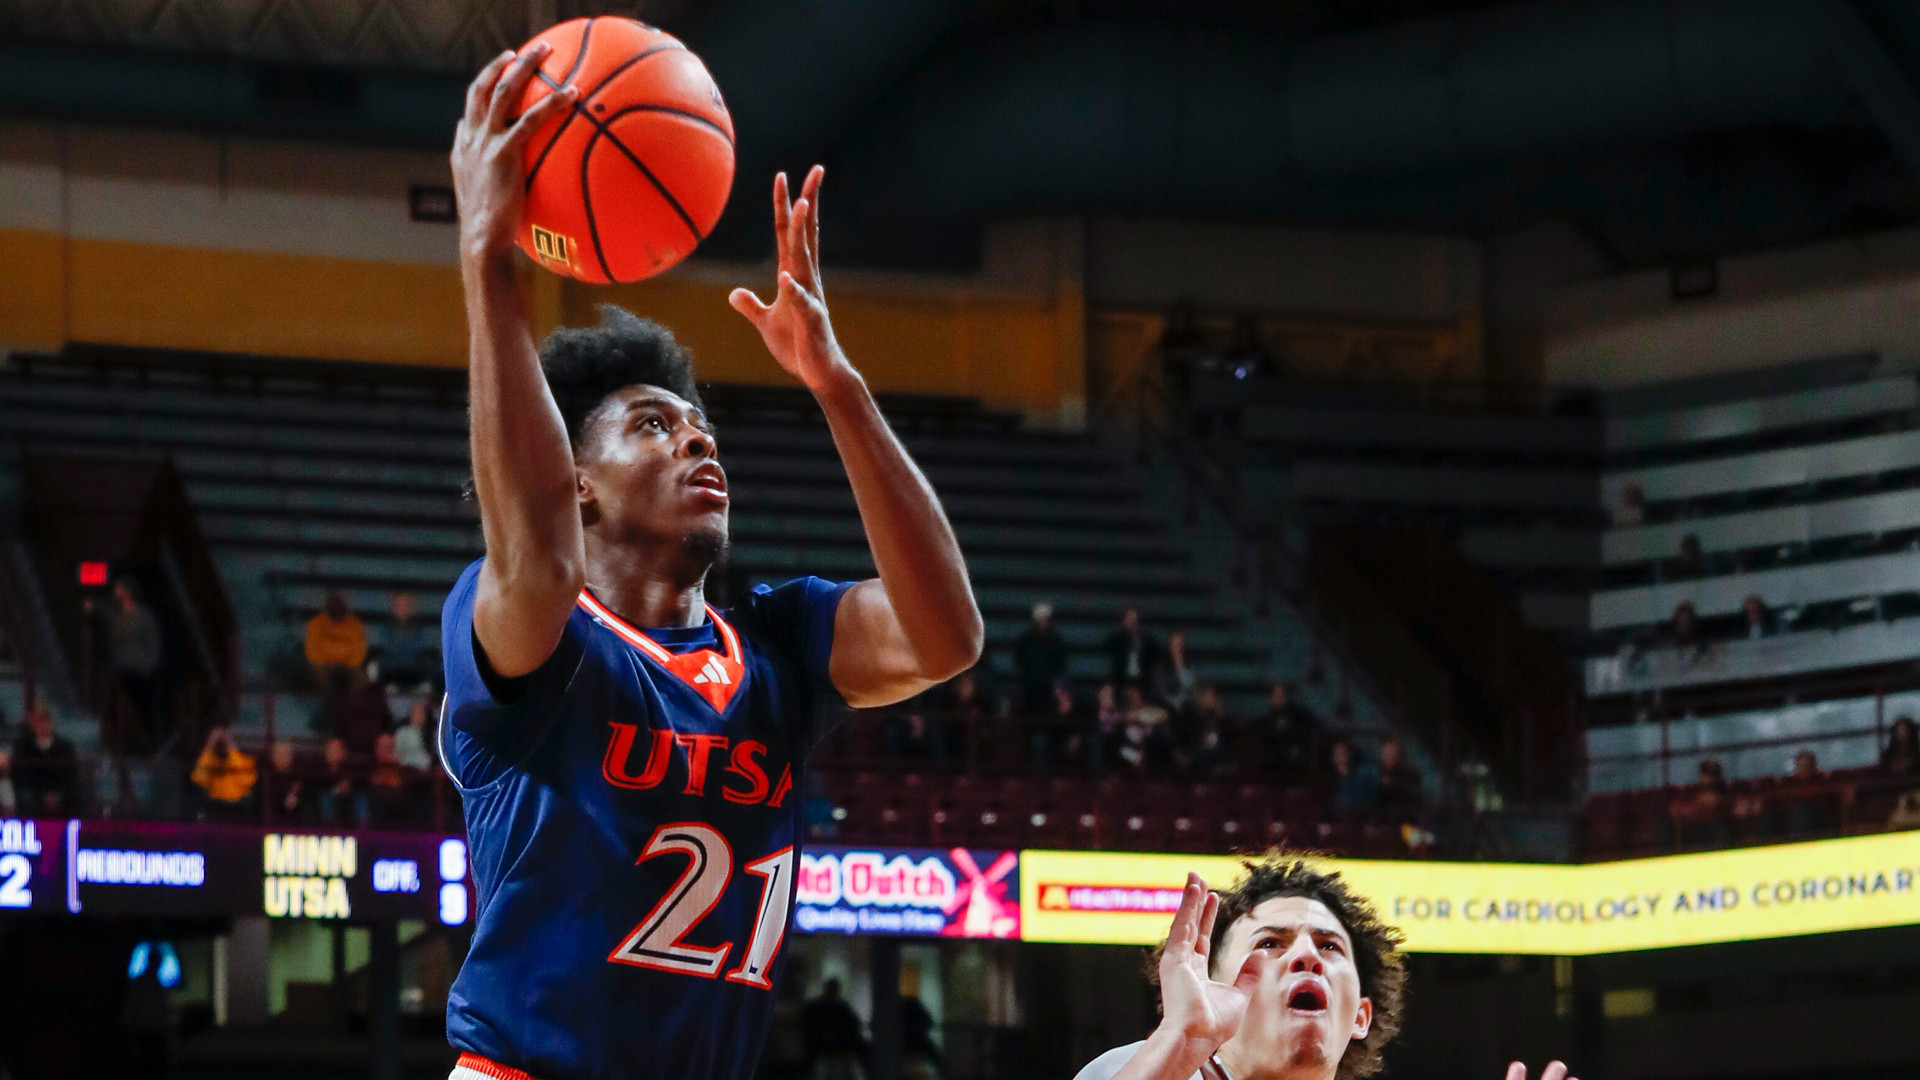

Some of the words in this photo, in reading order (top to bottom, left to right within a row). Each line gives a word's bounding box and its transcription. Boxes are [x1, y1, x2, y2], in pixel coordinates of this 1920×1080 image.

[0, 854, 32, 908] 2
[77, 849, 204, 886] REBOUNDS
[264, 834, 357, 877] MINN
[845, 853, 952, 904] Dutch
[264, 876, 351, 918] UTSA
[608, 821, 793, 990] 21
[1394, 896, 1452, 921] FOR
[1464, 895, 1661, 923] CARDIOLOGY
[1673, 886, 1739, 913] AND
[1752, 867, 1920, 906] CORONAR
